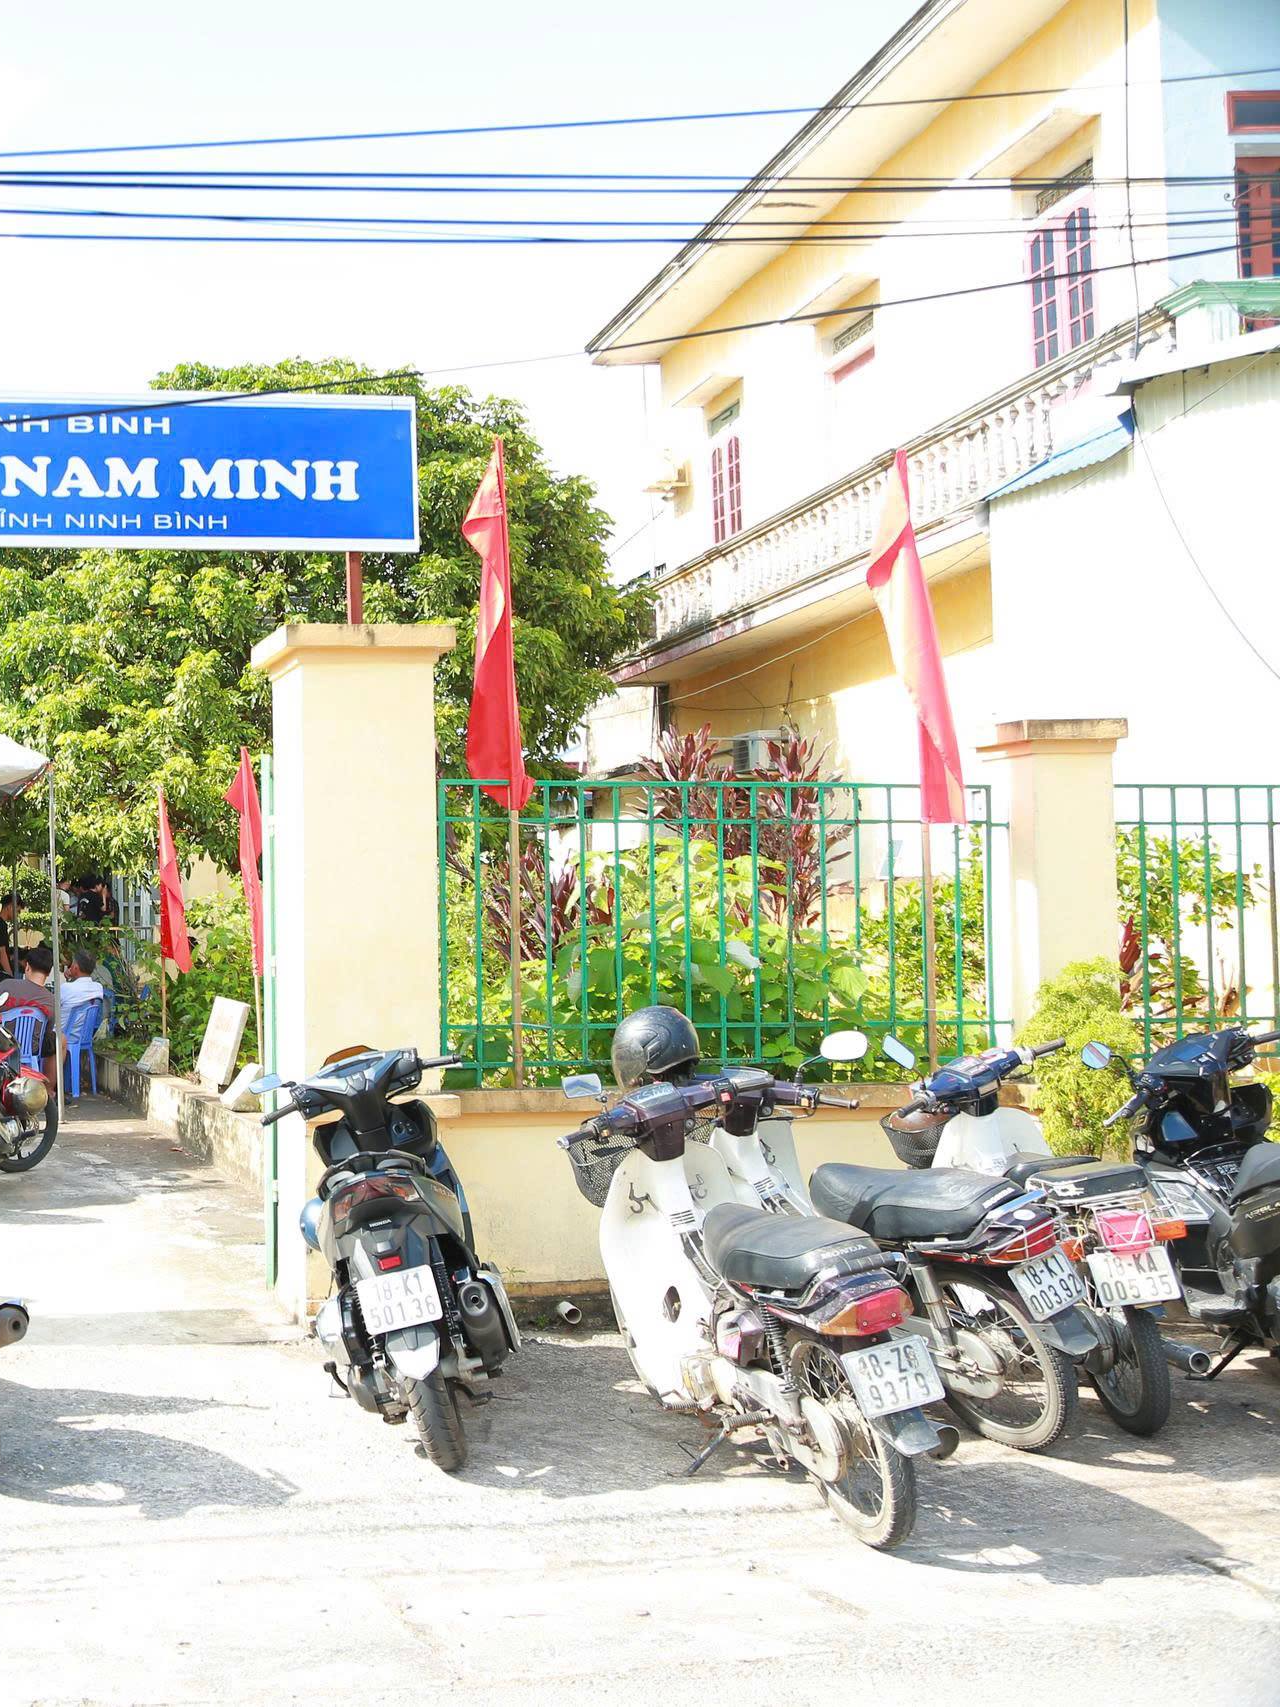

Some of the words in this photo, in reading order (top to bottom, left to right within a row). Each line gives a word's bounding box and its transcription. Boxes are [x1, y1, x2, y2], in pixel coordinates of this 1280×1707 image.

[68, 405, 171, 435] BÌNH
[0, 455, 160, 500] NAM
[179, 458, 360, 502] MINH
[65, 512, 142, 530] NINH
[154, 511, 229, 531] BÌNH
[1023, 1254, 1064, 1289] 18-K1
[1100, 1273, 1173, 1302] 00535
[1029, 1273, 1083, 1315] 003.92
[869, 1372, 930, 1410] 9379
